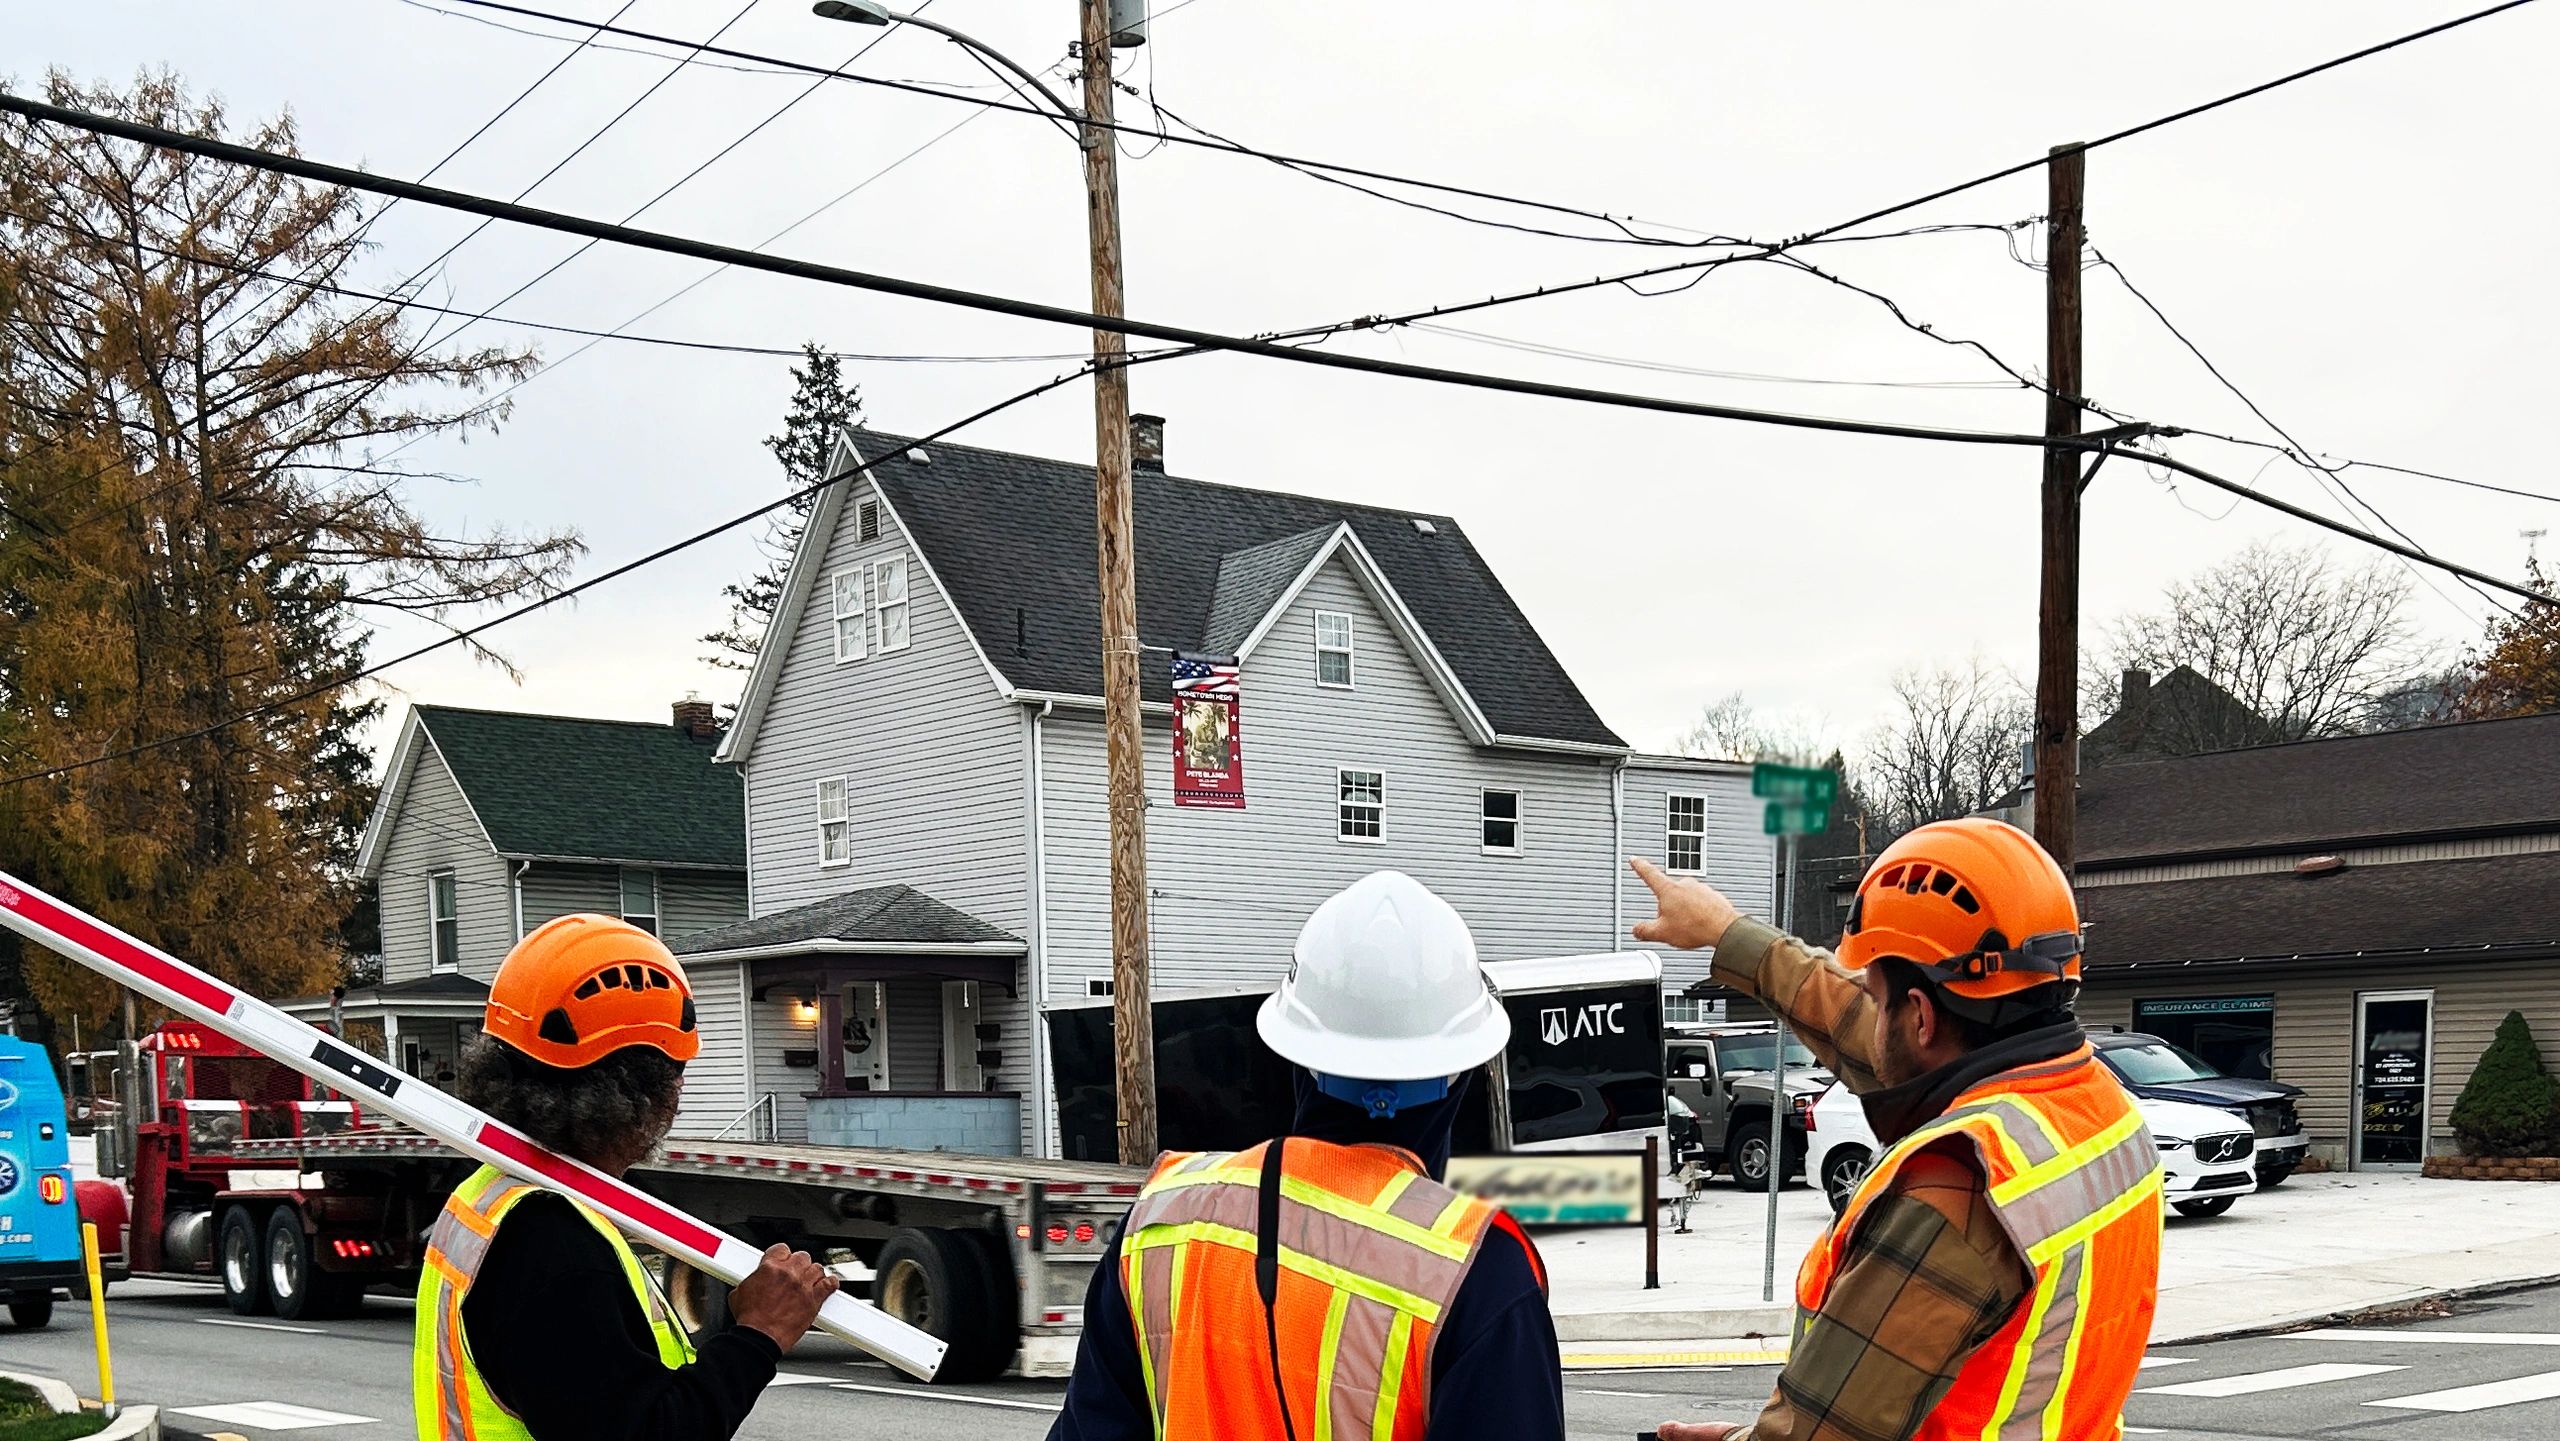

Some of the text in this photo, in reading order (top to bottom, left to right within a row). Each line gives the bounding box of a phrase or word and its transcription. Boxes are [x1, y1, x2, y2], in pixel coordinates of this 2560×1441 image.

[2143, 1000, 2273, 1012] INSURANCE CLAIMS
[1573, 1002, 1625, 1038] ATC
